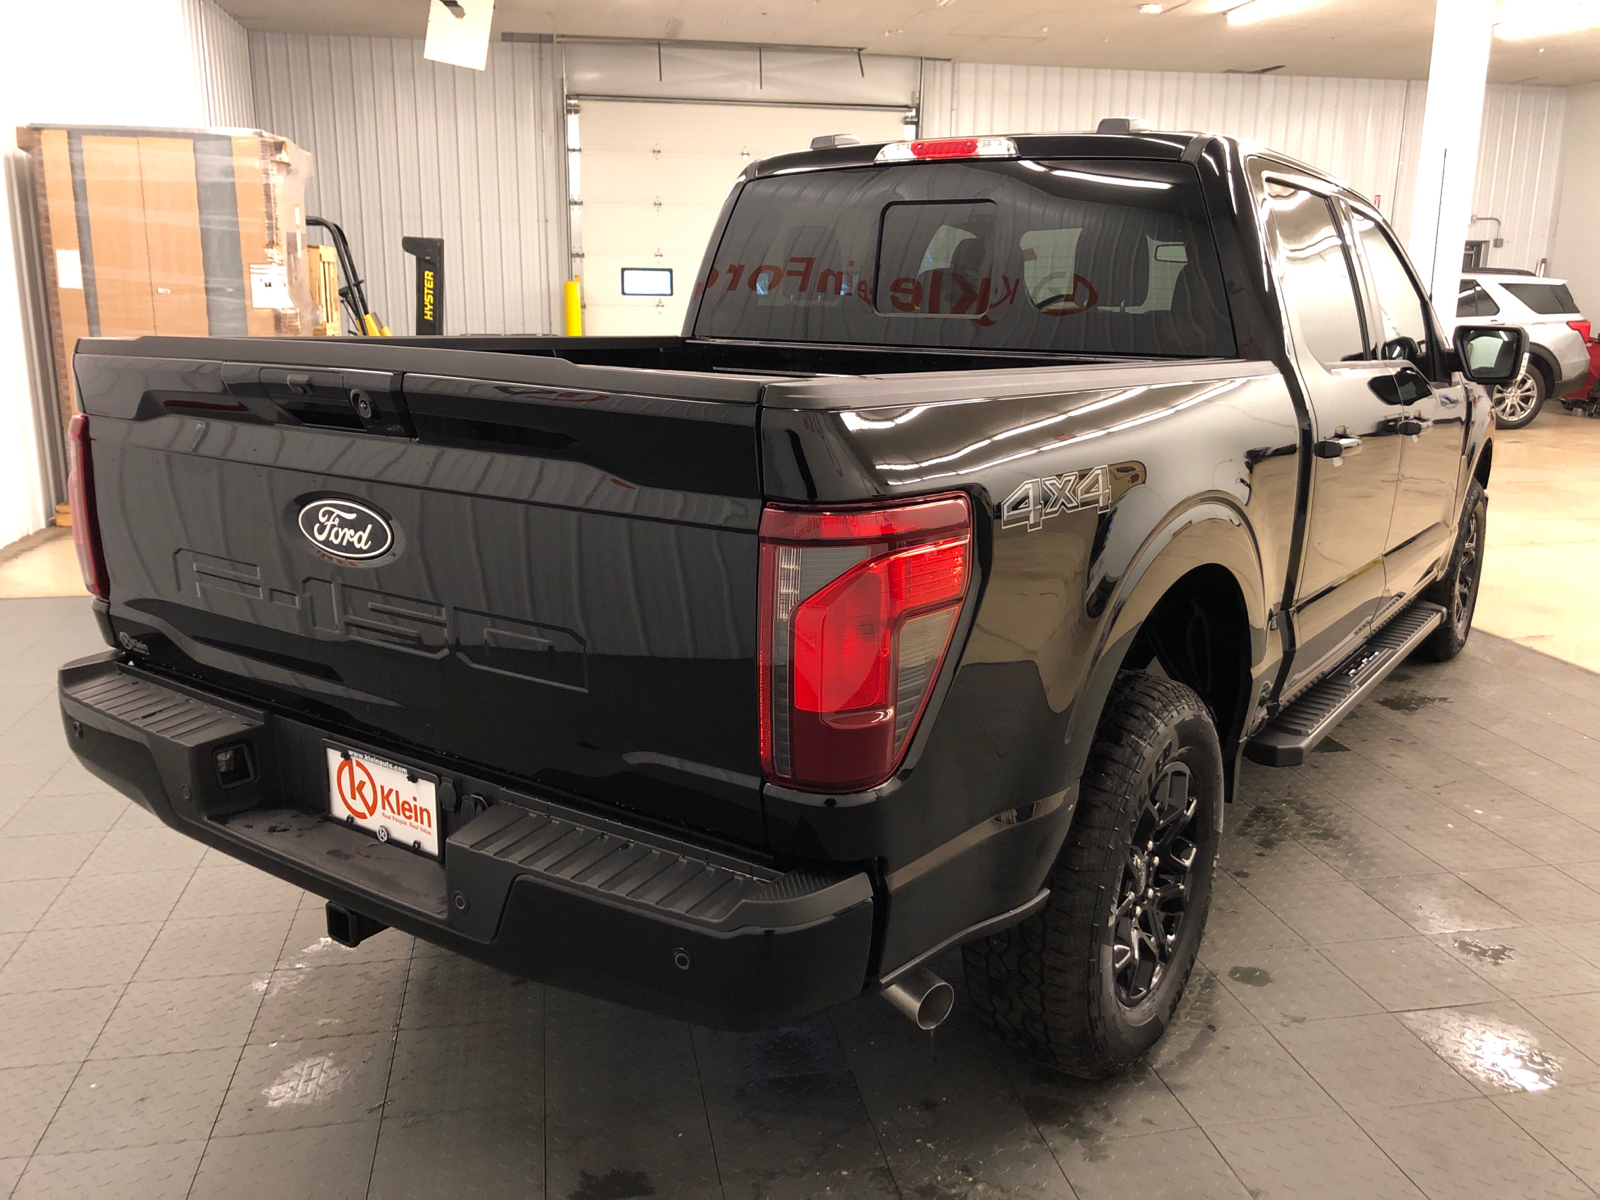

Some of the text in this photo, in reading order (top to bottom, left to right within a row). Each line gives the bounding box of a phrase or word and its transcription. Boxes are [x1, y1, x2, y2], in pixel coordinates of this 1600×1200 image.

[423, 270, 434, 321] HYSTER
[313, 506, 373, 550] Ford
[347, 749, 408, 775] www.kleinauto.com
[380, 784, 432, 829] Klein
[382, 812, 392, 820] Real
[409, 821, 419, 829] Real
